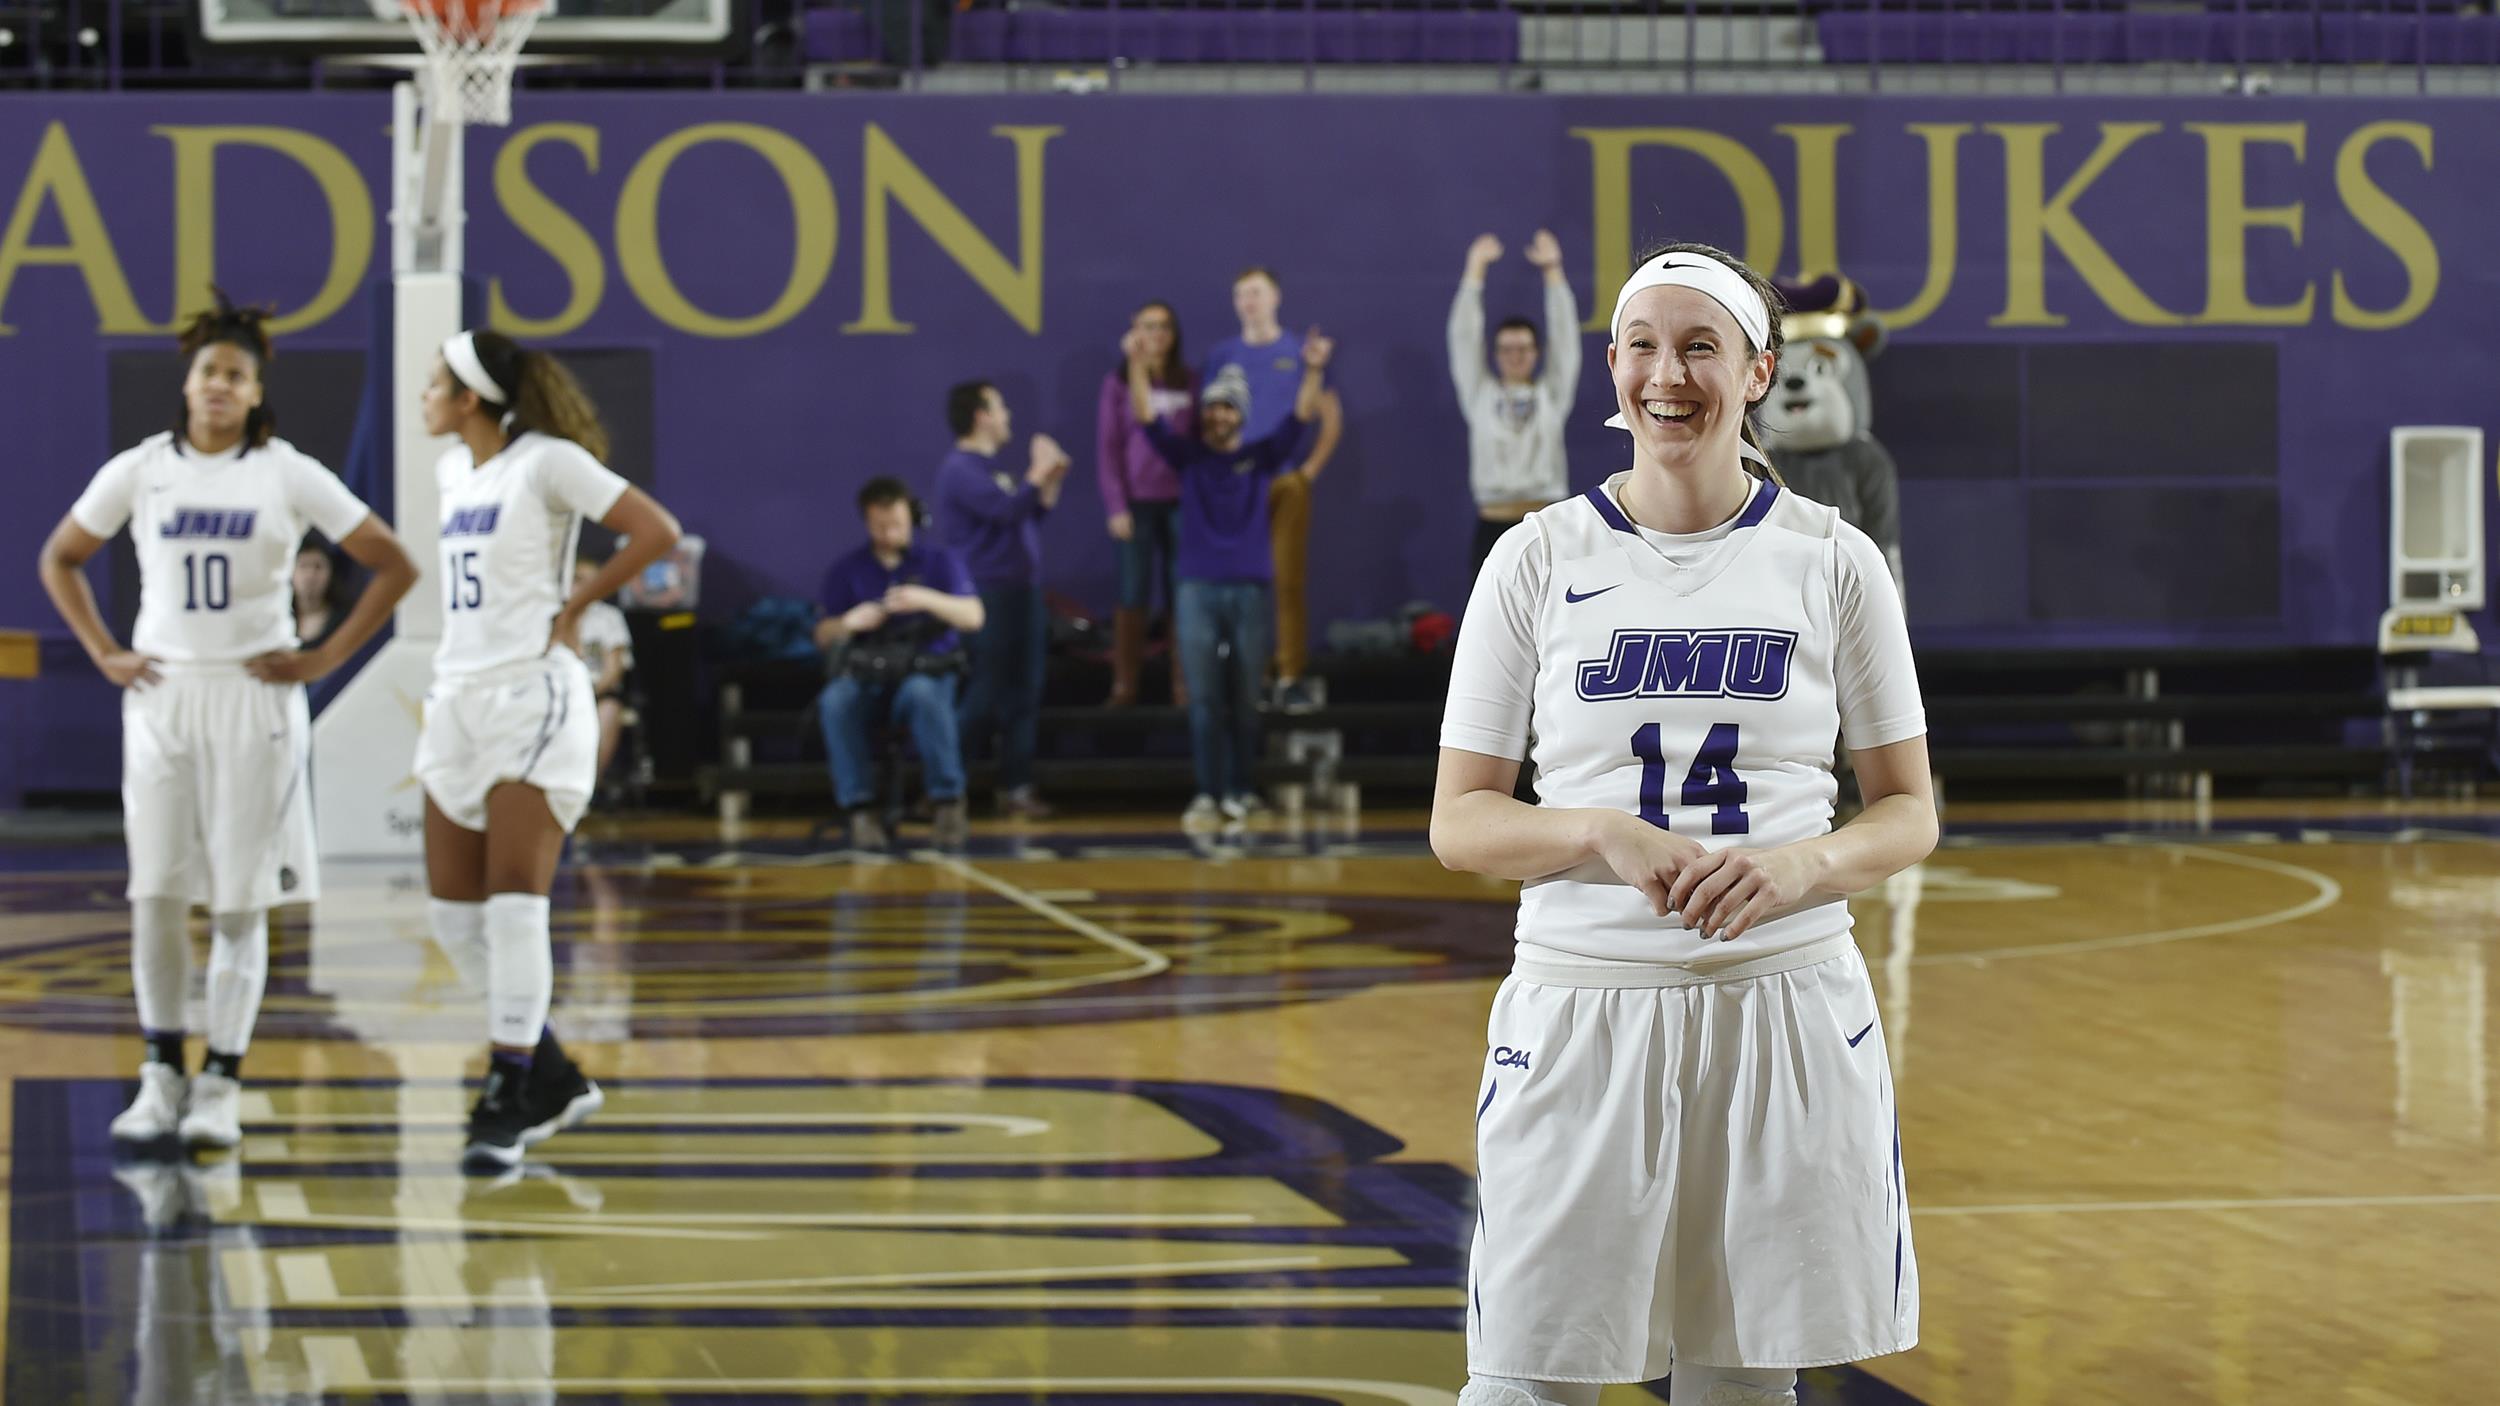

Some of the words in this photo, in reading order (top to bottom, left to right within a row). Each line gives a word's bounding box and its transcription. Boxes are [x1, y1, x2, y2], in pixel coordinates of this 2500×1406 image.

[0, 119, 1066, 338] ADSON
[1568, 120, 2440, 330] DUKES
[160, 507, 257, 540] JMU
[183, 553, 230, 612] 10
[450, 551, 482, 610] 15
[1576, 627, 1798, 701] JMU
[1631, 722, 1750, 835] 14
[1494, 1046, 1531, 1070] CAA
